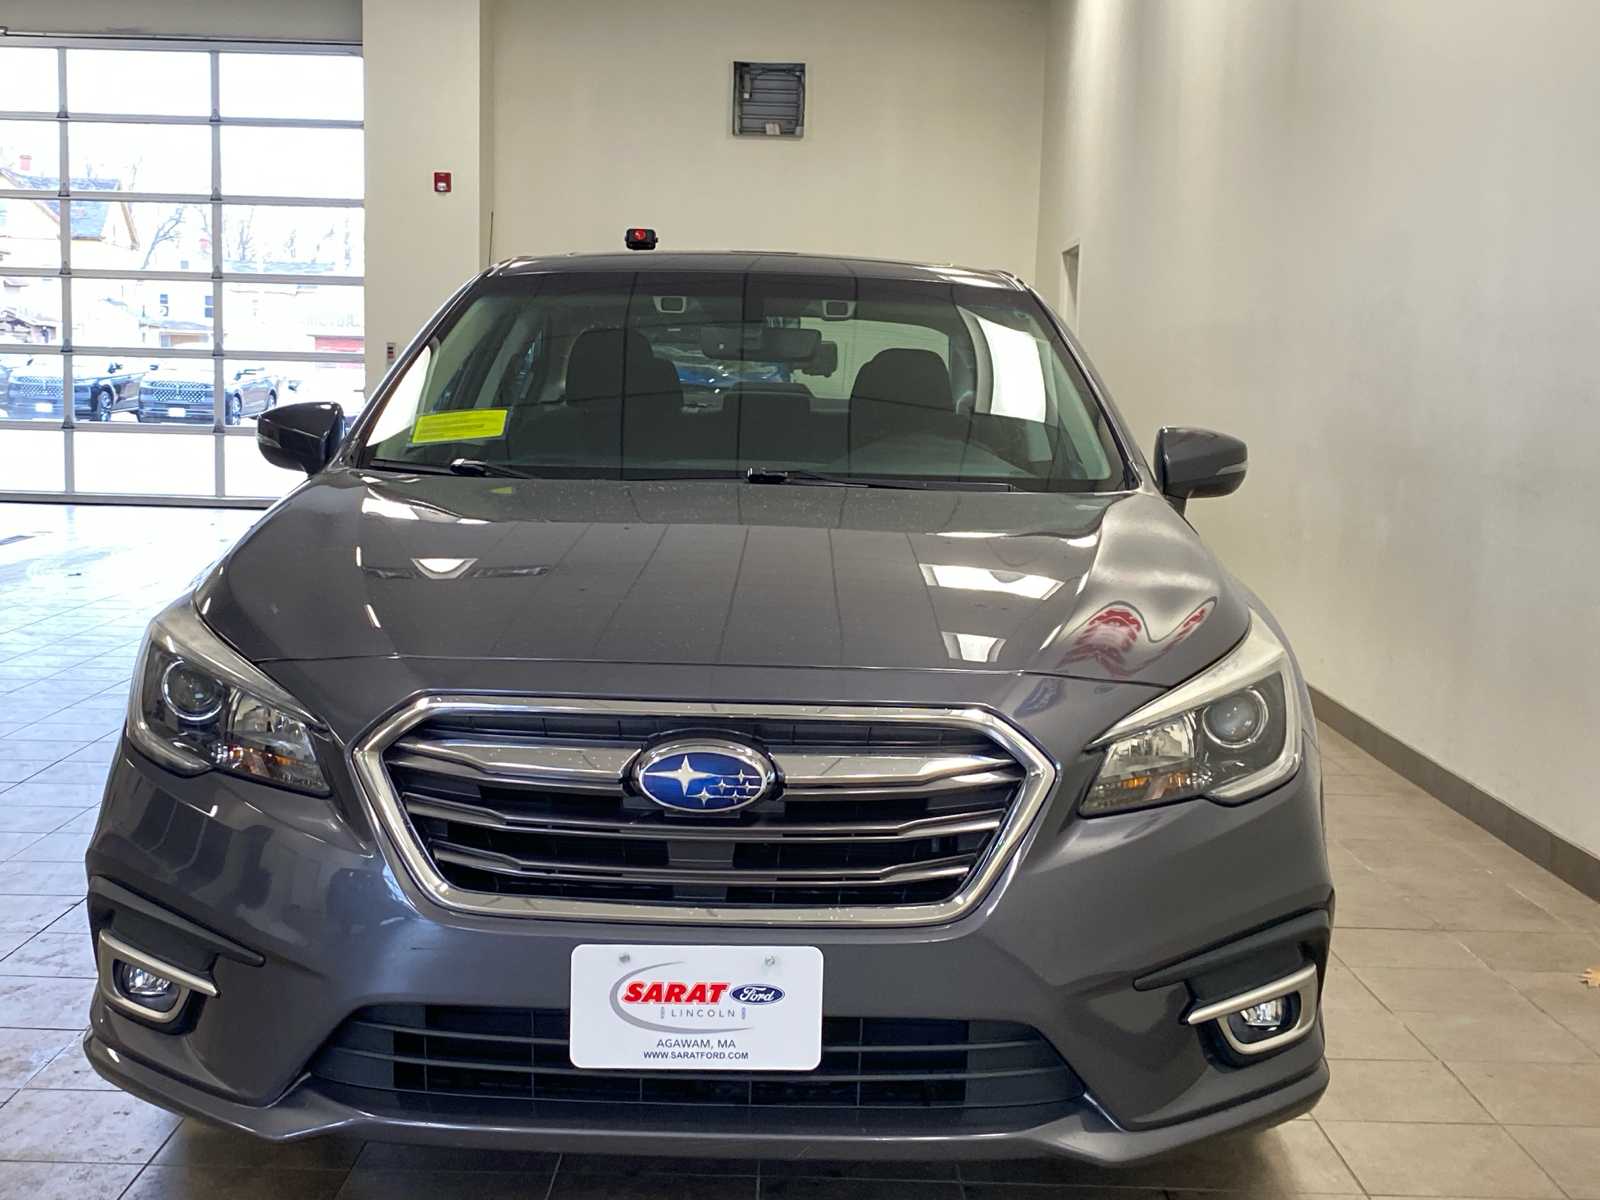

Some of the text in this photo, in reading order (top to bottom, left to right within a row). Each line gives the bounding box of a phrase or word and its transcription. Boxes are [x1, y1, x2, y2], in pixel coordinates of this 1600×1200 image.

[622, 981, 775, 1005] SARAT Ford
[671, 1009, 735, 1018] LINCOLN
[656, 1039, 737, 1051] AGAWAM, MA
[643, 1051, 749, 1060] WWW.SARATFORD.COM
